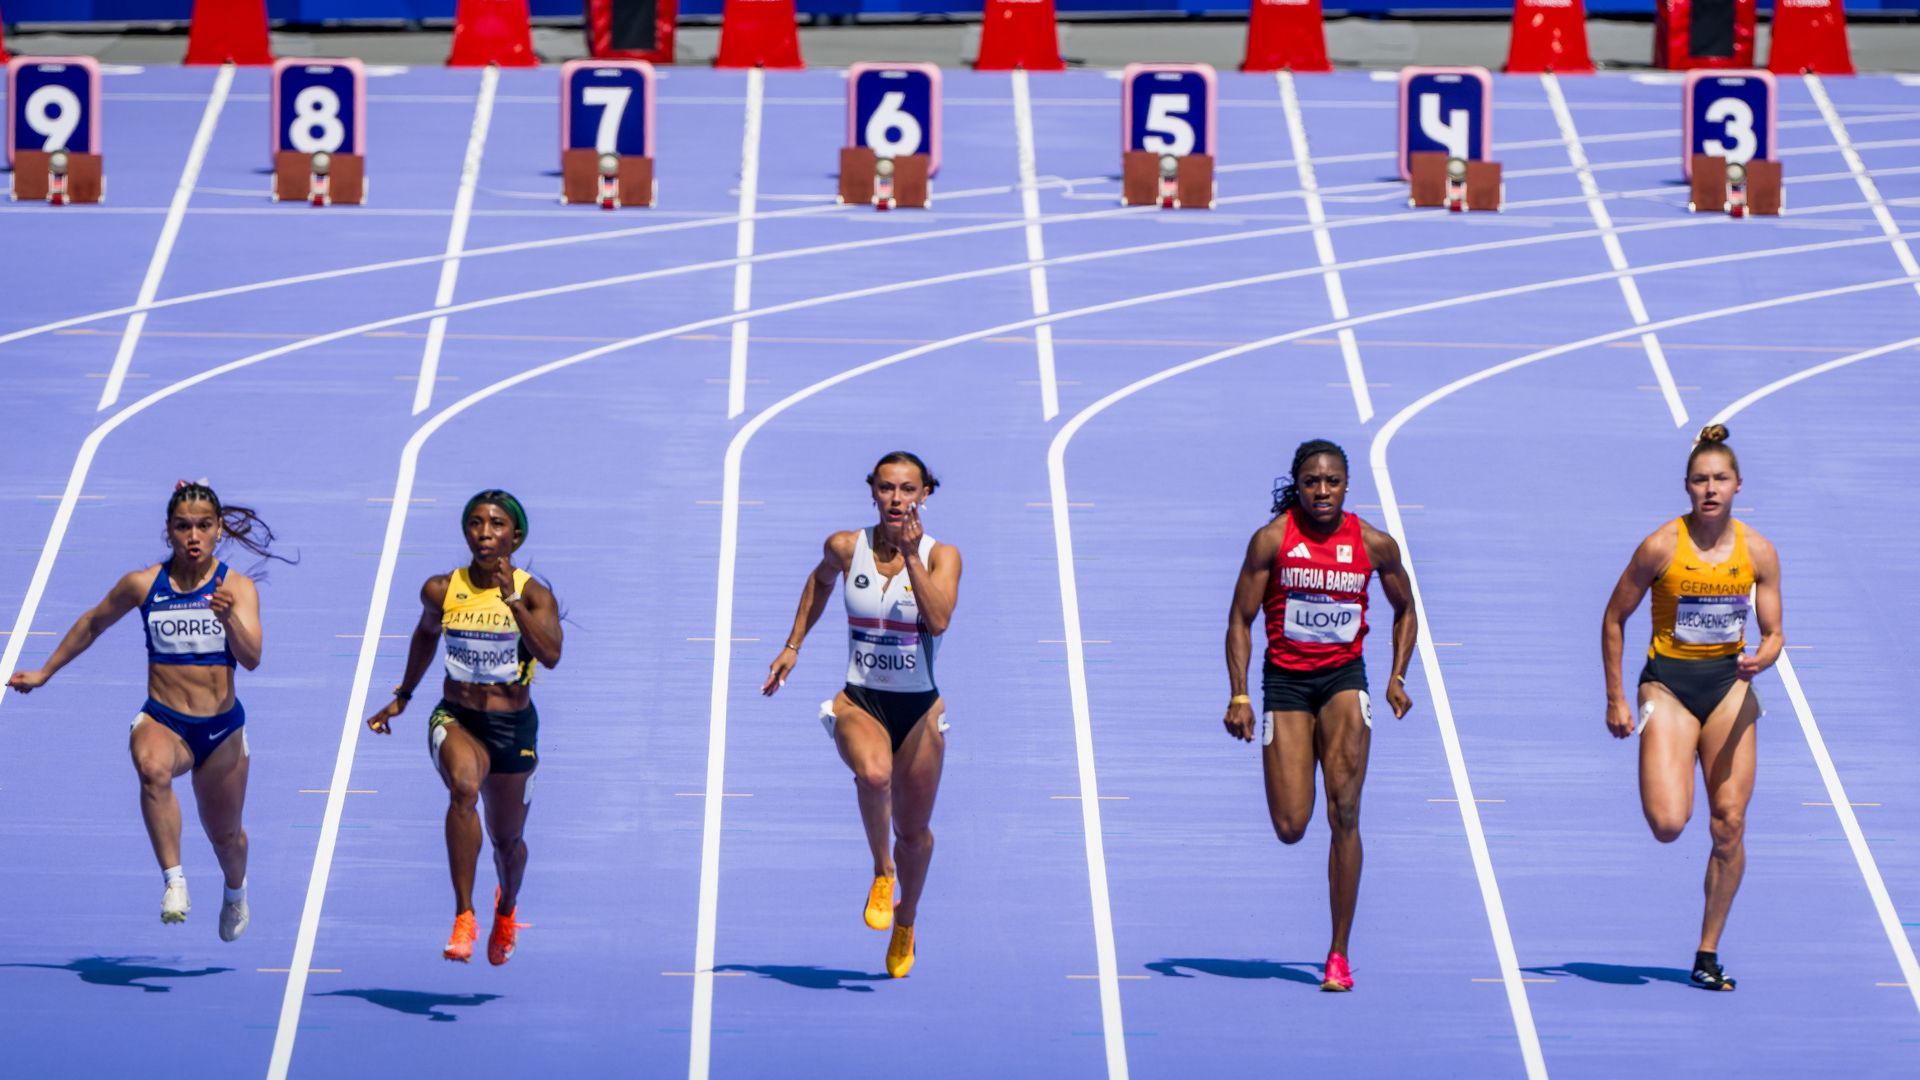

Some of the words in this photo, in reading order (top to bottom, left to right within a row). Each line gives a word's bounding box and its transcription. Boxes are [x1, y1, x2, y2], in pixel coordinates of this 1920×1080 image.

[25, 85, 81, 152] 9
[289, 86, 345, 153] 8
[582, 87, 632, 154] 7
[865, 91, 921, 157] 6
[1142, 93, 1195, 157] 5
[1419, 92, 1470, 160] 4
[1702, 97, 1757, 163] 3
[1280, 567, 1324, 589] ANTIGUA
[1680, 580, 1750, 595] GERMANY
[151, 619, 222, 637] TORRES
[449, 611, 512, 628] JAMAICA
[1295, 610, 1352, 628] LLOYD
[854, 651, 916, 671] ROSIUS
